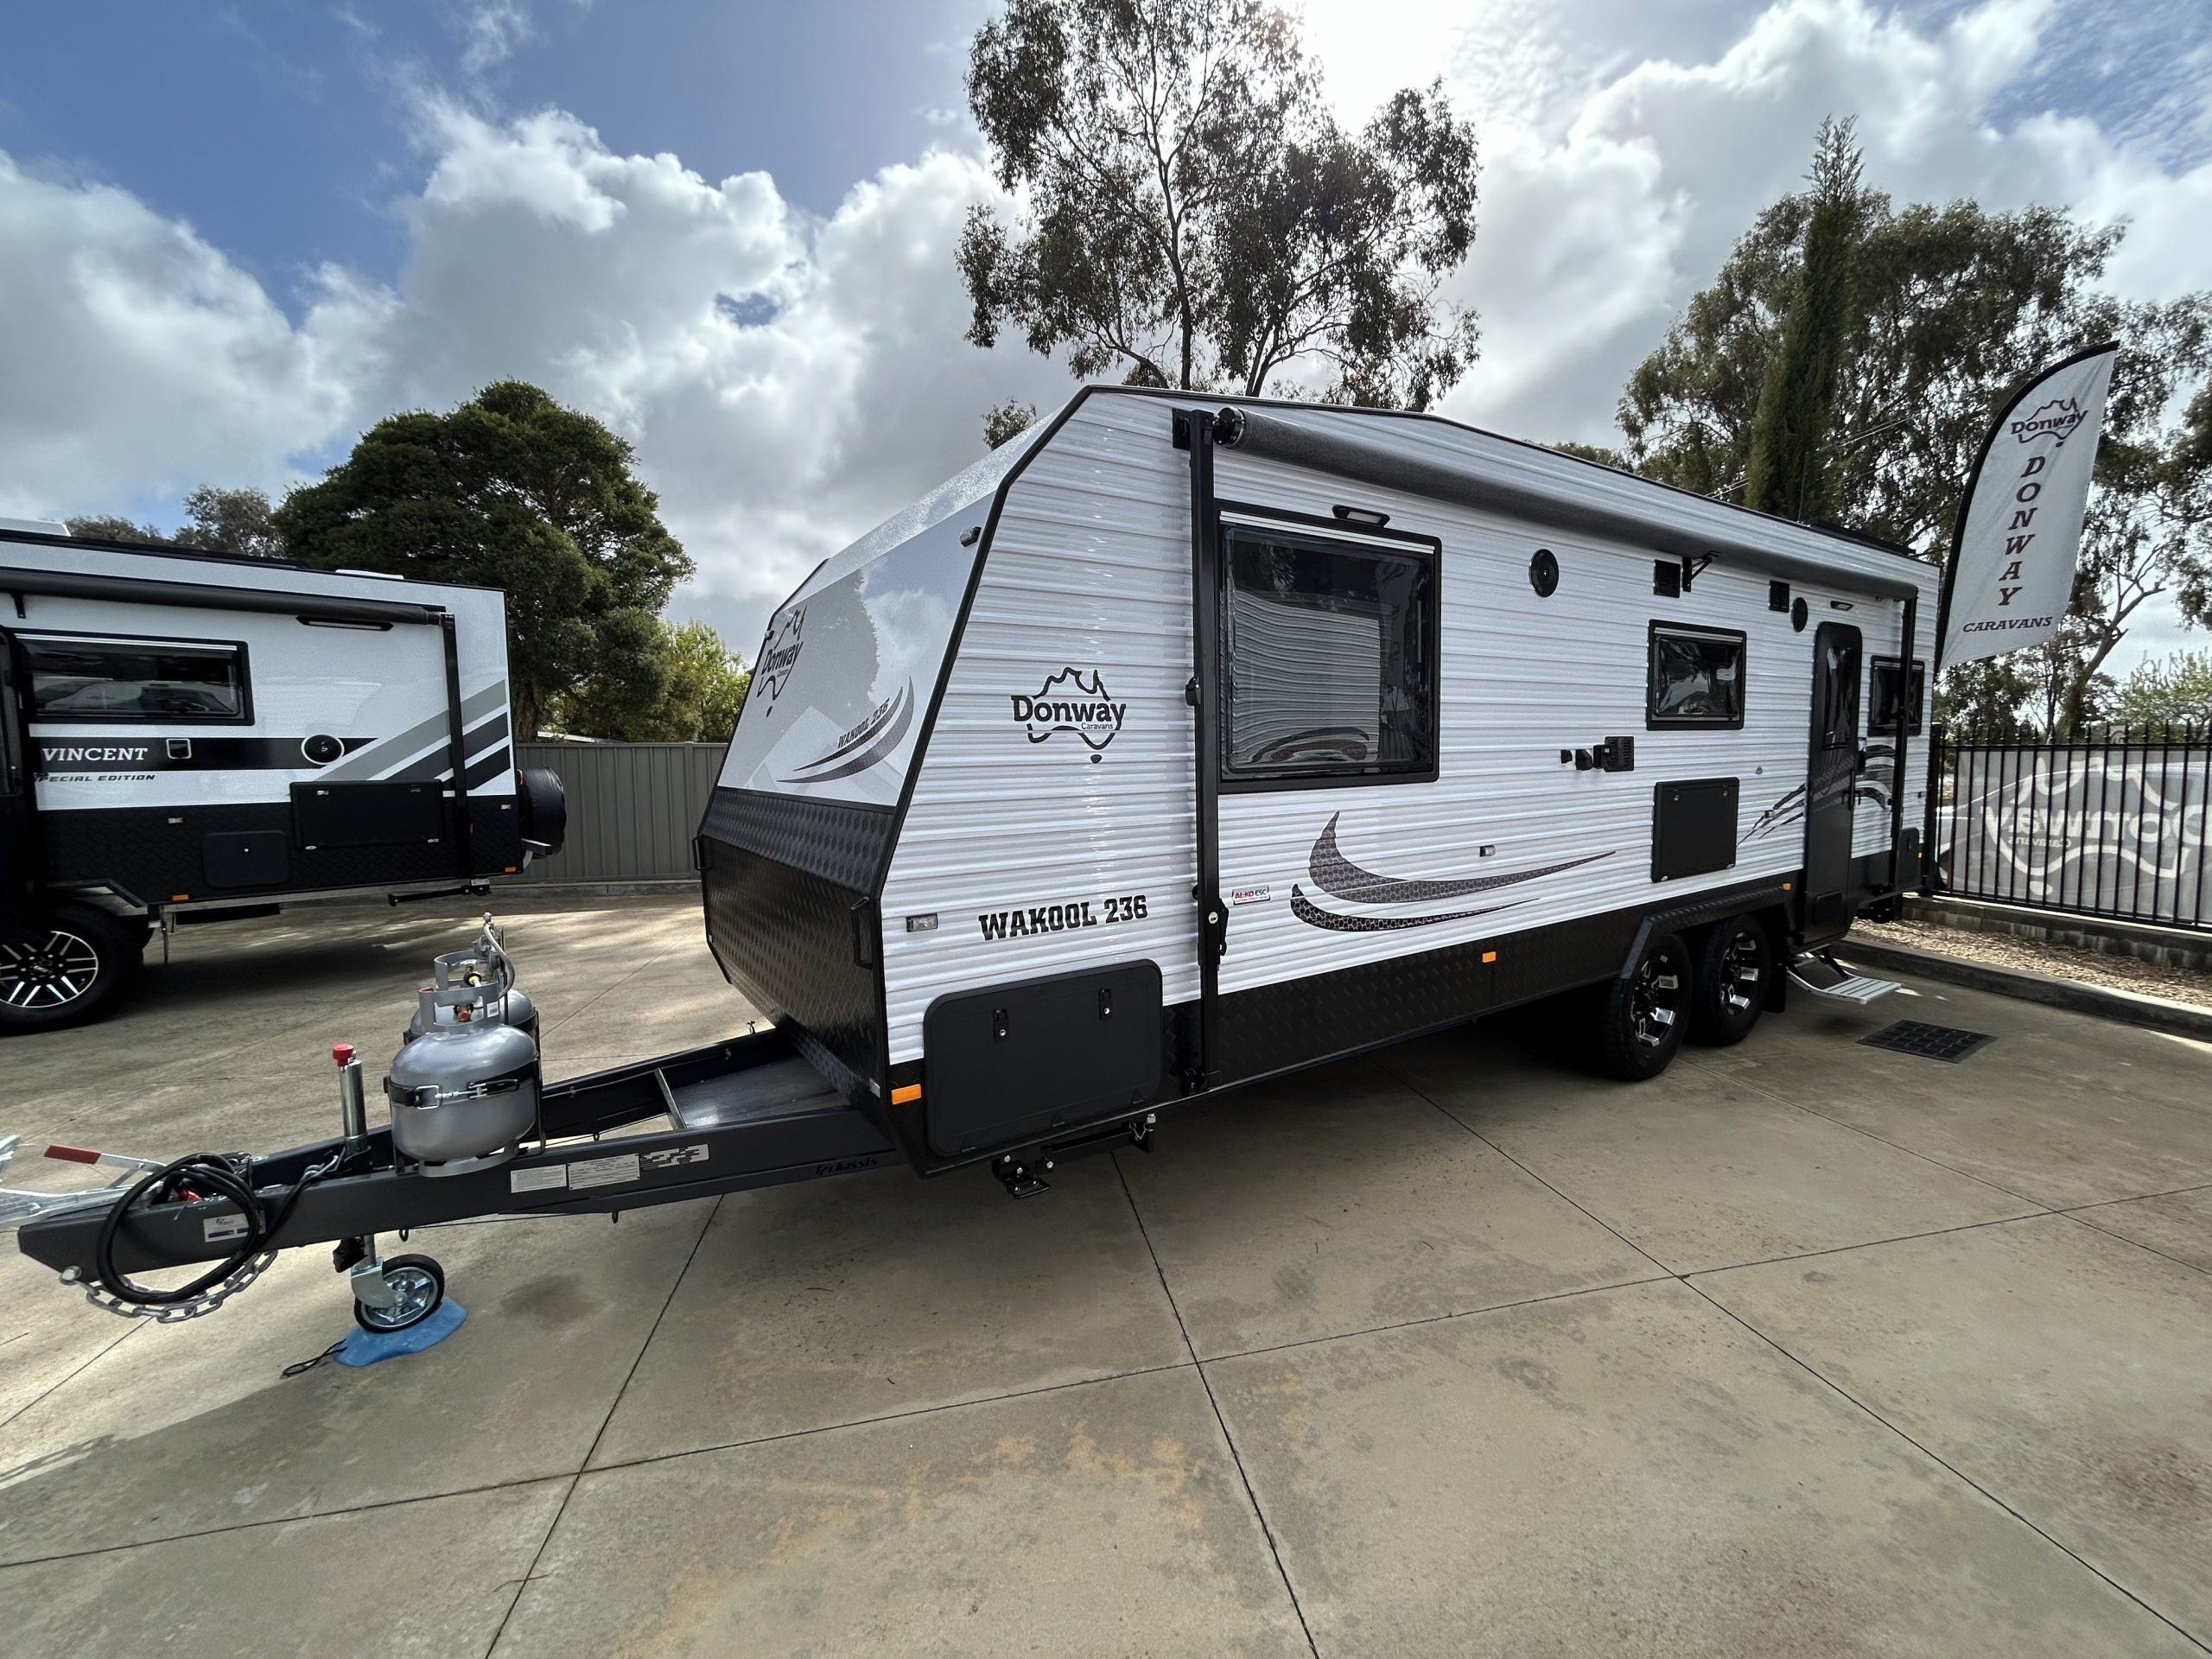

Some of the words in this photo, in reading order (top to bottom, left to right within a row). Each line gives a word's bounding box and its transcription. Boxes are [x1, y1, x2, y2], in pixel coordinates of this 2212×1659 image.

[2012, 410, 2088, 435] Donway
[1999, 456, 2045, 606] DONWAY
[1963, 617, 2052, 632] CARAVANS
[1011, 696, 1126, 722] Donway
[42, 747, 148, 761] VINCENT
[978, 902, 1097, 941] WAKOOL
[1103, 894, 1148, 924] 236
